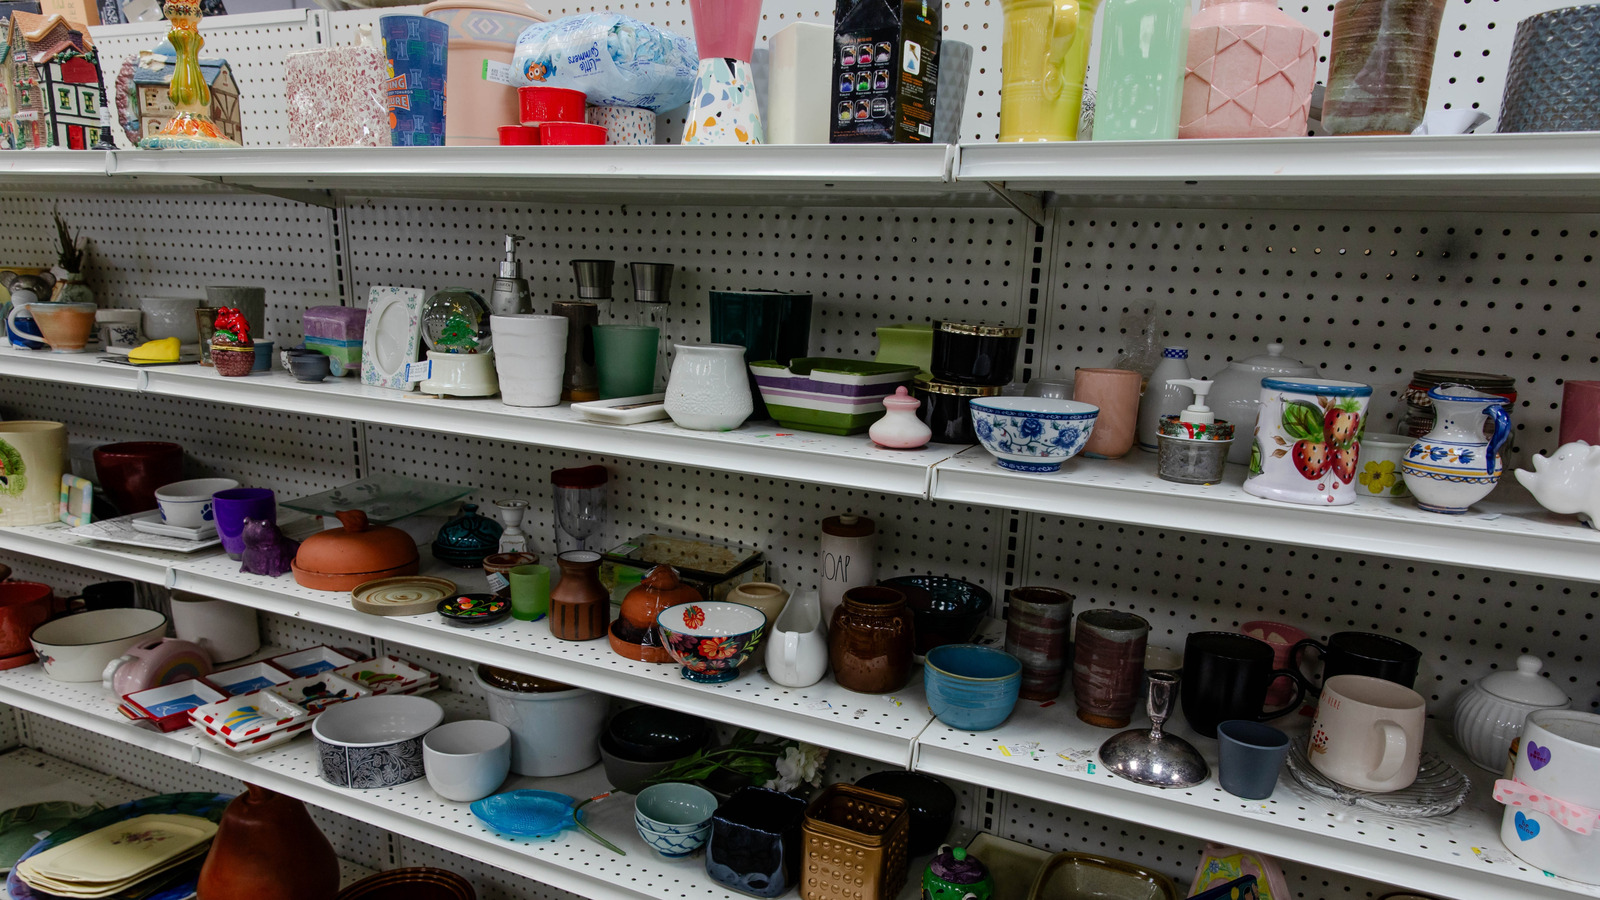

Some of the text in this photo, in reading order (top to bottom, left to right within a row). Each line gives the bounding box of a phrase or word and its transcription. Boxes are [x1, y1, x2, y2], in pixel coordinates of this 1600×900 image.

[579, 58, 597, 73] Little
[821, 550, 850, 583] SOAP
[1518, 823, 1534, 835] mine
[1521, 819, 1529, 828] be
